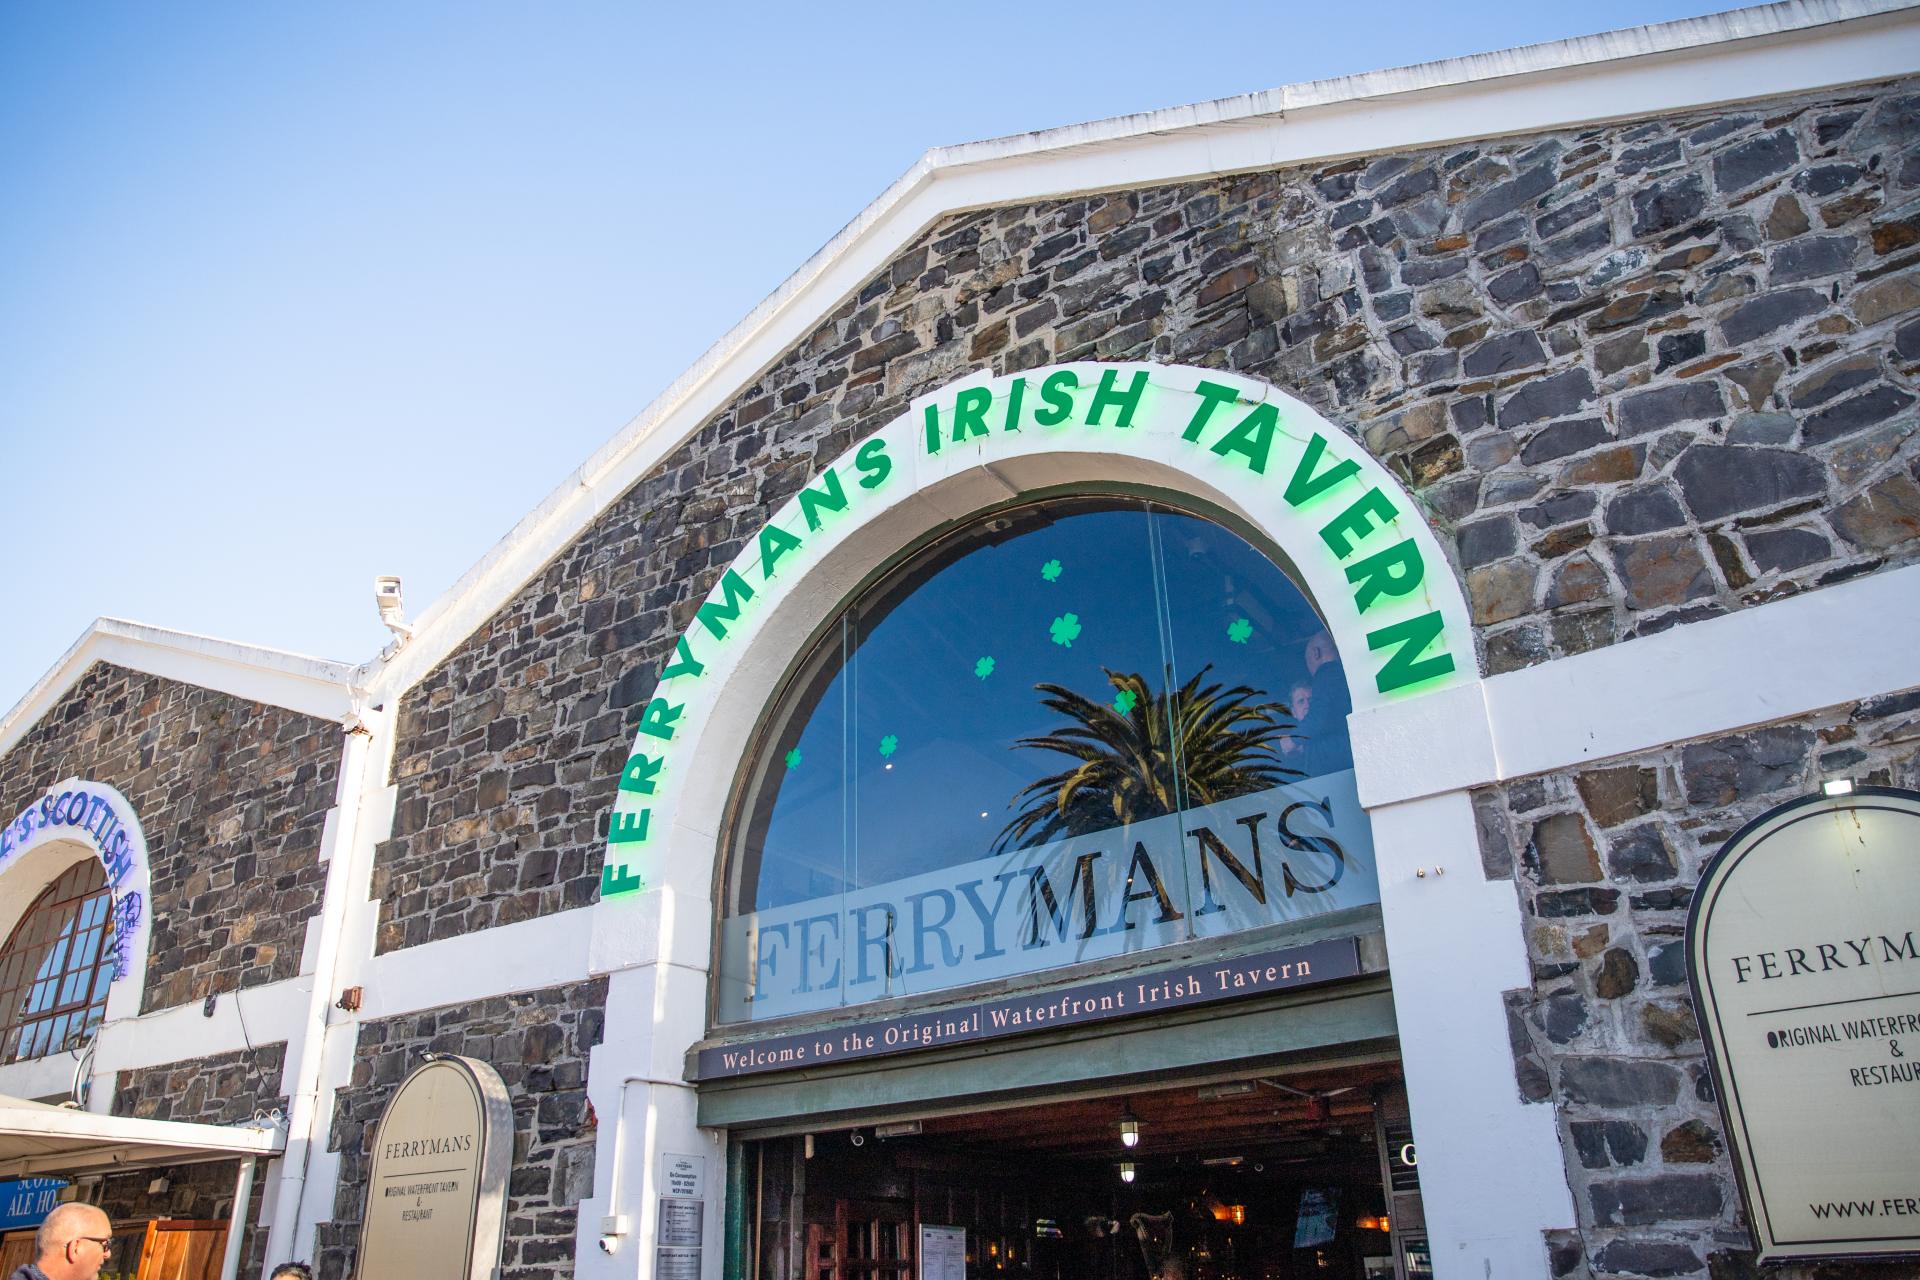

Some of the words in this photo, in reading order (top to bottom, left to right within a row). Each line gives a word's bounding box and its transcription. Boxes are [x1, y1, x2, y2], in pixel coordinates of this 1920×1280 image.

[600, 438, 892, 897] FERRYMANS
[924, 369, 1150, 455] IRISH
[1181, 380, 1456, 694] TAVERN
[38, 791, 132, 888] SCOTTISH
[750, 796, 1346, 1002] FERRYMANS
[722, 1045, 805, 1070] Welcome
[815, 1040, 833, 1057] to
[843, 1032, 875, 1052] the
[884, 1012, 980, 1045] Original
[991, 990, 1125, 1029] Waterfront
[1137, 974, 1202, 1004] Irish
[1215, 959, 1312, 991] Tavern
[1767, 1024, 1841, 1049] ORIGINAL
[1842, 1013, 1920, 1040] WATERFR
[1889, 1039, 1904, 1058] &
[385, 1134, 472, 1160] FERRYMANS
[6, 1192, 34, 1217] ALE
[1809, 1198, 1920, 1219] WWW.FER
